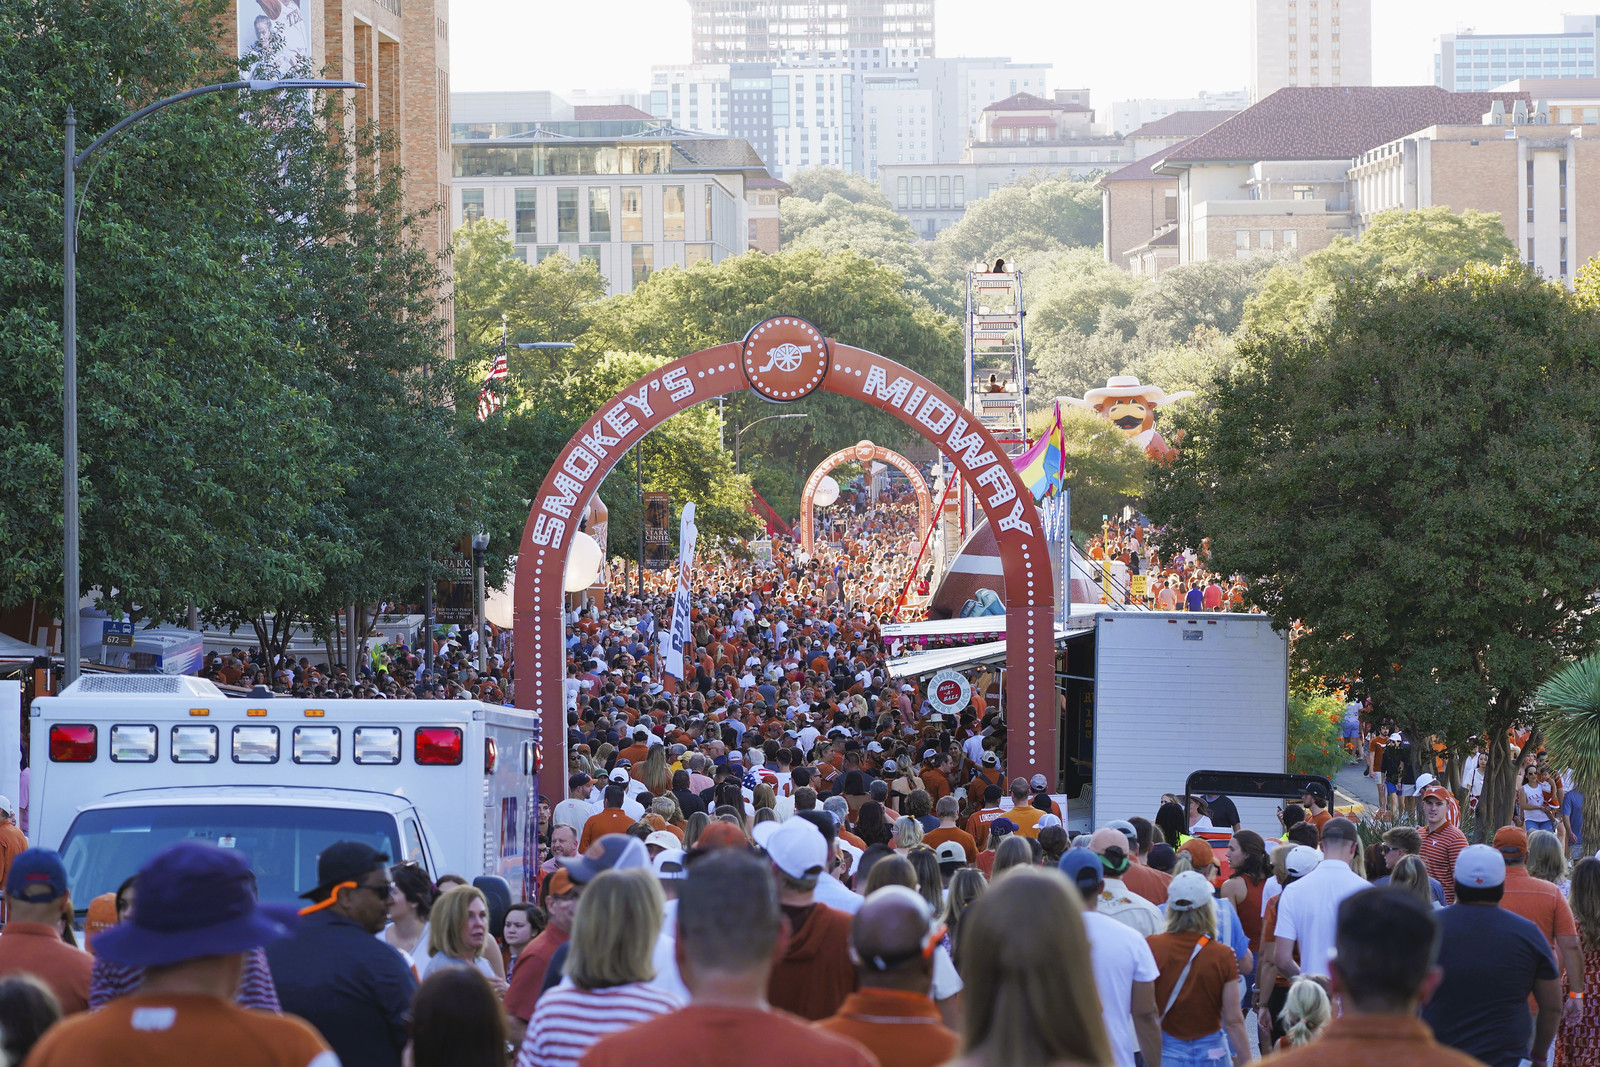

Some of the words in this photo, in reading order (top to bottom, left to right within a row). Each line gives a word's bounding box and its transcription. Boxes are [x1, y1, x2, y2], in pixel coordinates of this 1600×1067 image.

[532, 366, 695, 549] SMOKEY'S
[862, 364, 1034, 537] MIDWAY
[805, 451, 846, 498] SMOKEY'S
[885, 452, 927, 495] MIDWAY
[672, 591, 687, 654] GATE
[680, 560, 691, 591] 16
[107, 635, 120, 644] 672
[939, 683, 956, 691] ROLL
[943, 693, 959, 702] BALL
